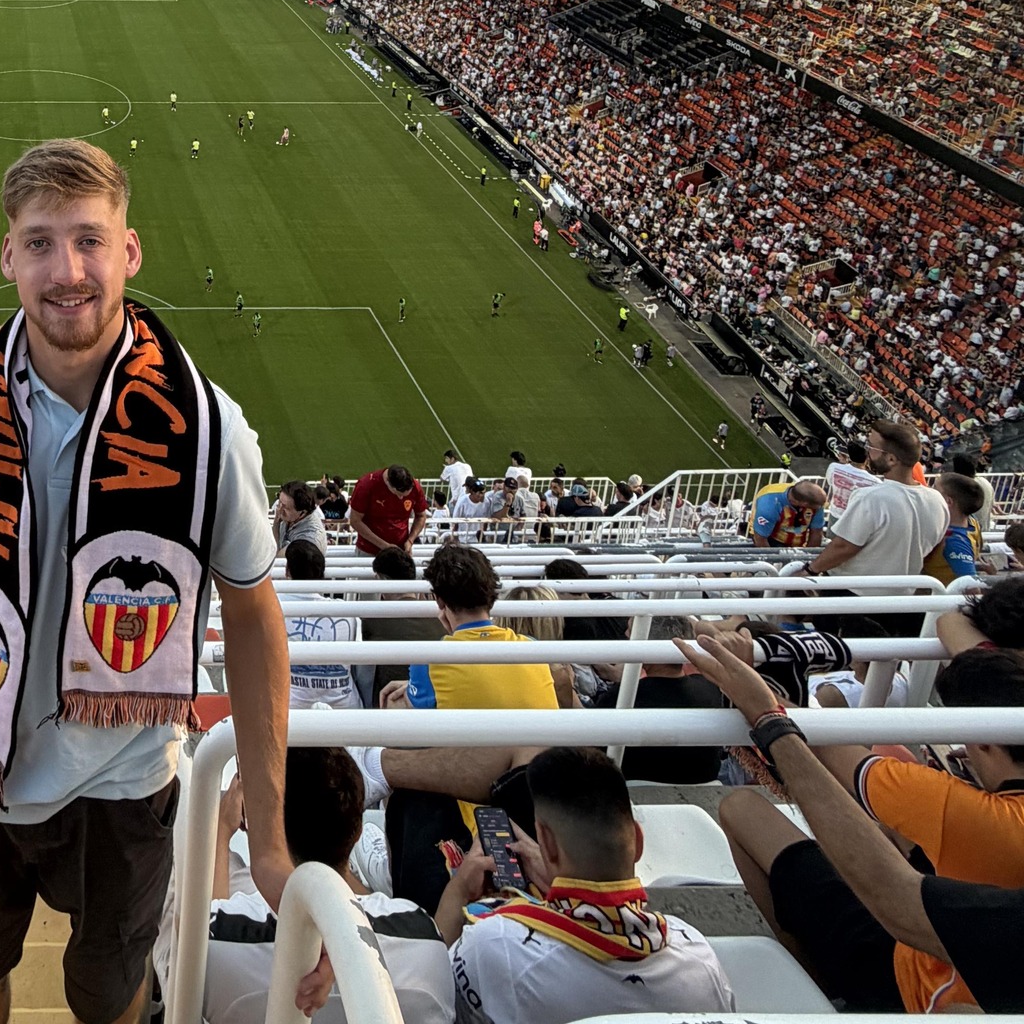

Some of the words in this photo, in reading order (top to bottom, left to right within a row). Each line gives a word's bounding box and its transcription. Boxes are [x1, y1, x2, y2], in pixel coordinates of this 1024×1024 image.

[726, 38, 751, 57] SKODA
[949, 551, 974, 562] divina
[92, 594, 151, 606] VALENCIA
[291, 676, 310, 688] ASTAL
[311, 678, 330, 689] STATE
[453, 937, 483, 1010] vina
